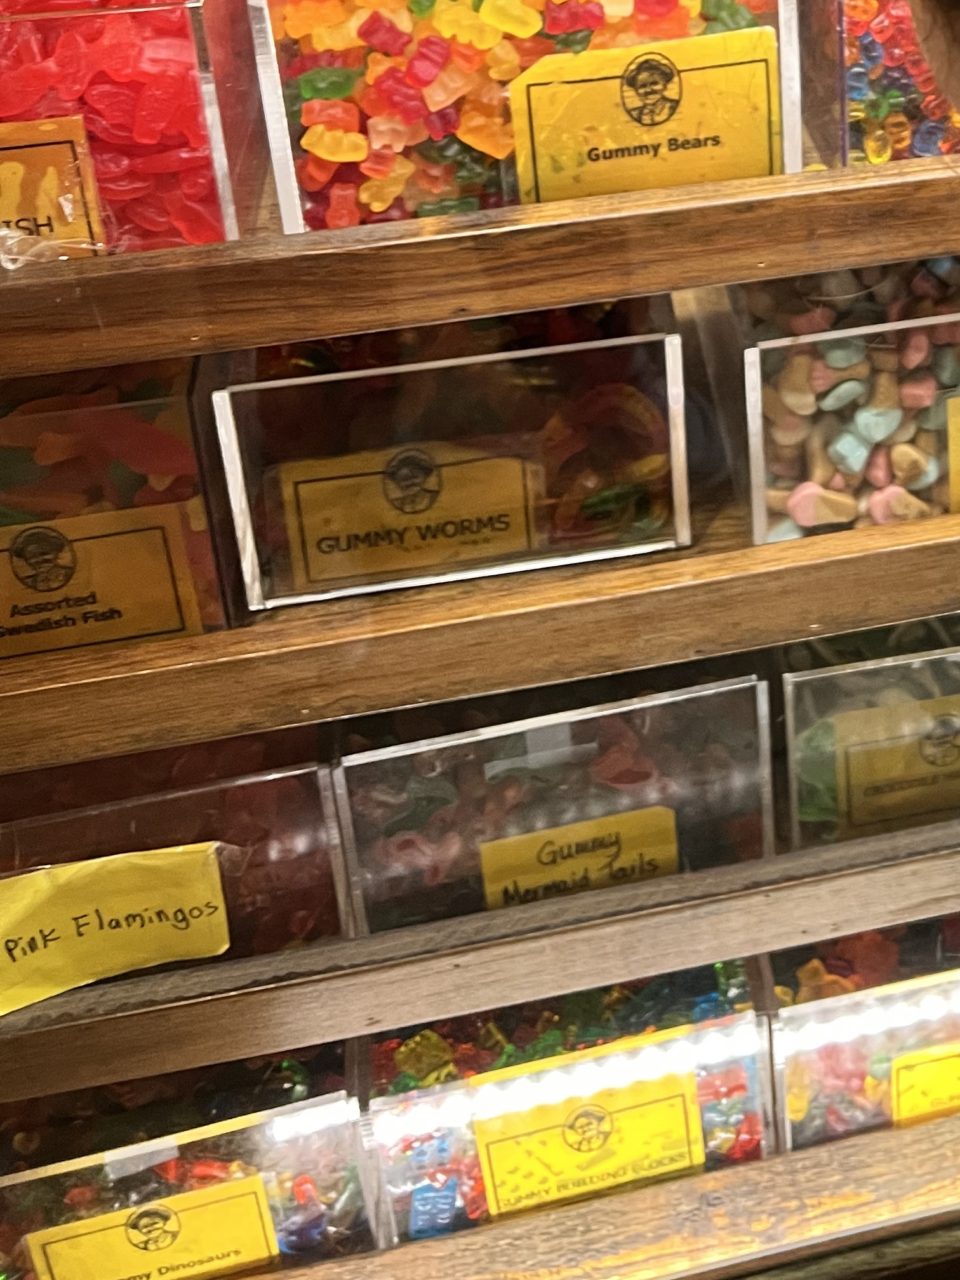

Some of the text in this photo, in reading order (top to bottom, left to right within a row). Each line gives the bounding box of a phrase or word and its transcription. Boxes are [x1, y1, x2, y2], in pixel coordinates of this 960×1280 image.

[587, 133, 721, 163] Gummy Bears
[315, 525, 410, 555] GUMMY
[416, 513, 512, 542] WORMS
[9, 591, 97, 619] Assorted
[81, 607, 123, 625] Fish
[536, 831, 623, 872] Gummy
[4, 900, 220, 963] Pink Flamingos
[157, 1248, 242, 1276] Dinosaurs
